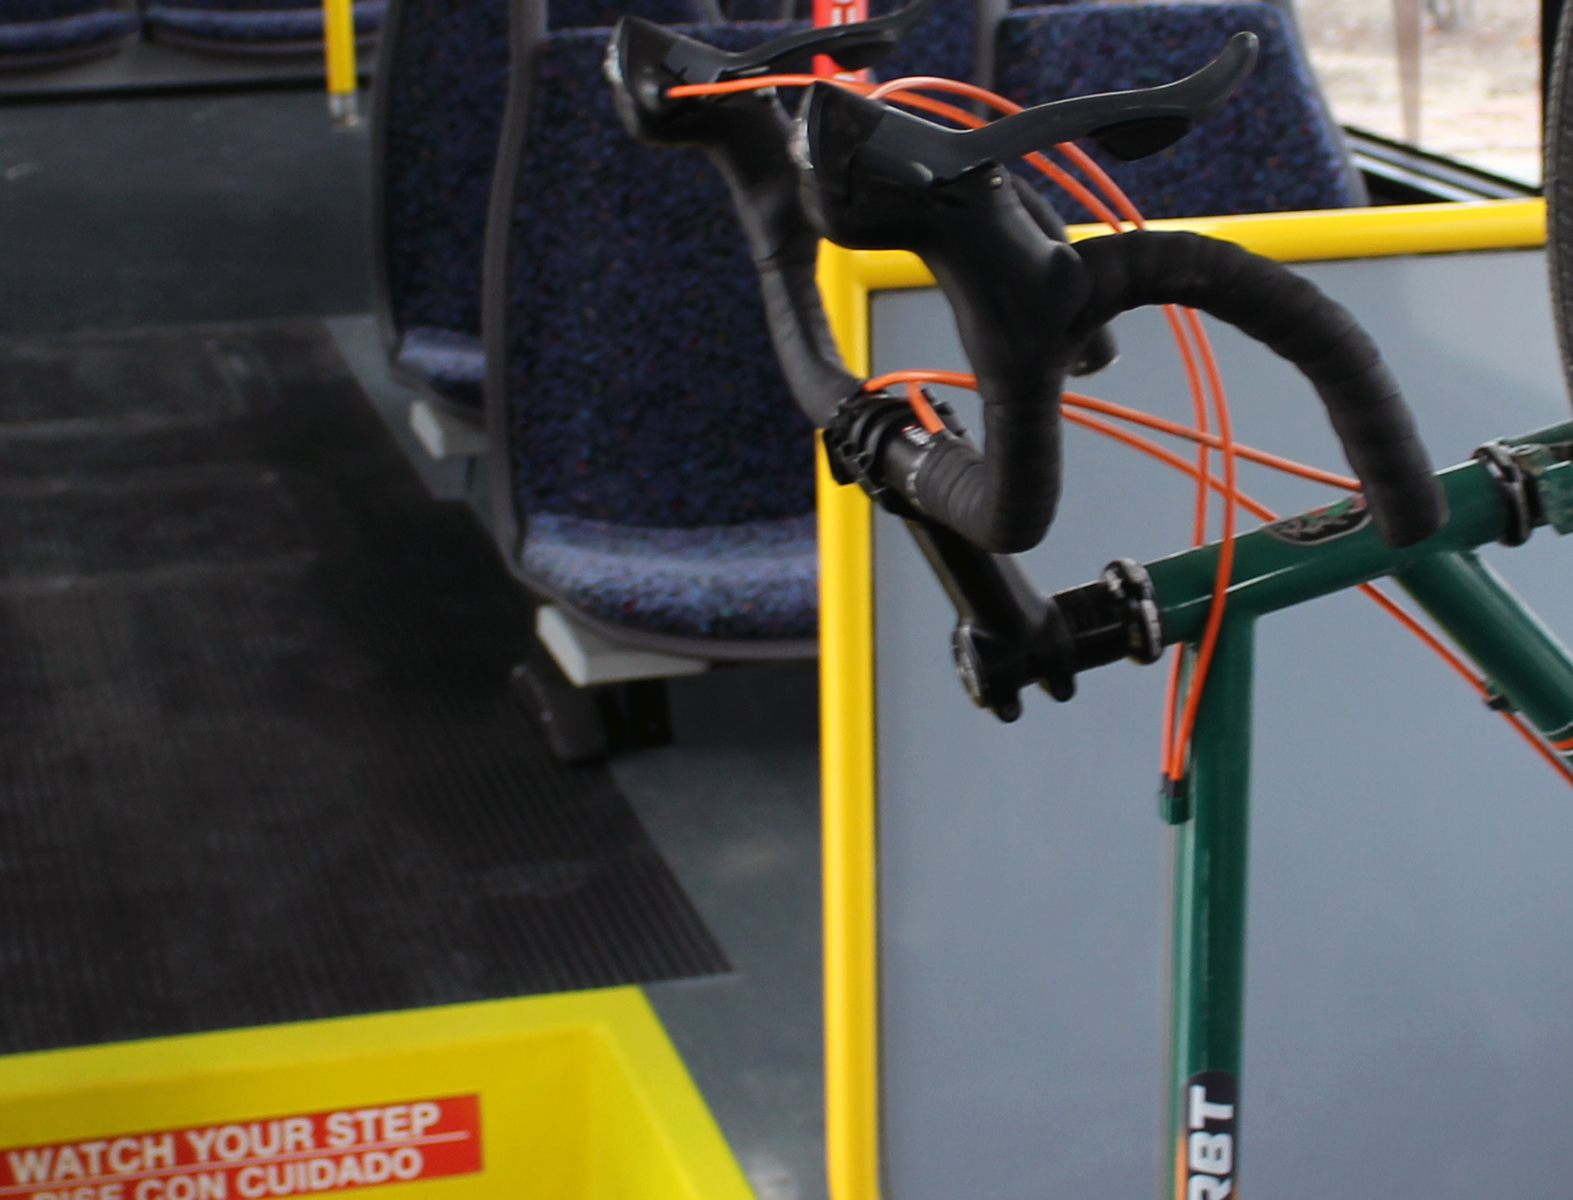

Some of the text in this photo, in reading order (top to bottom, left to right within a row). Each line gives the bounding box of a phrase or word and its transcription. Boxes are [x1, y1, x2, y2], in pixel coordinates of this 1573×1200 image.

[8, 1102, 442, 1184] WATCH YOUR STEP
[135, 1171, 228, 1200] CON
[236, 1147, 424, 1198] CUIDADO
